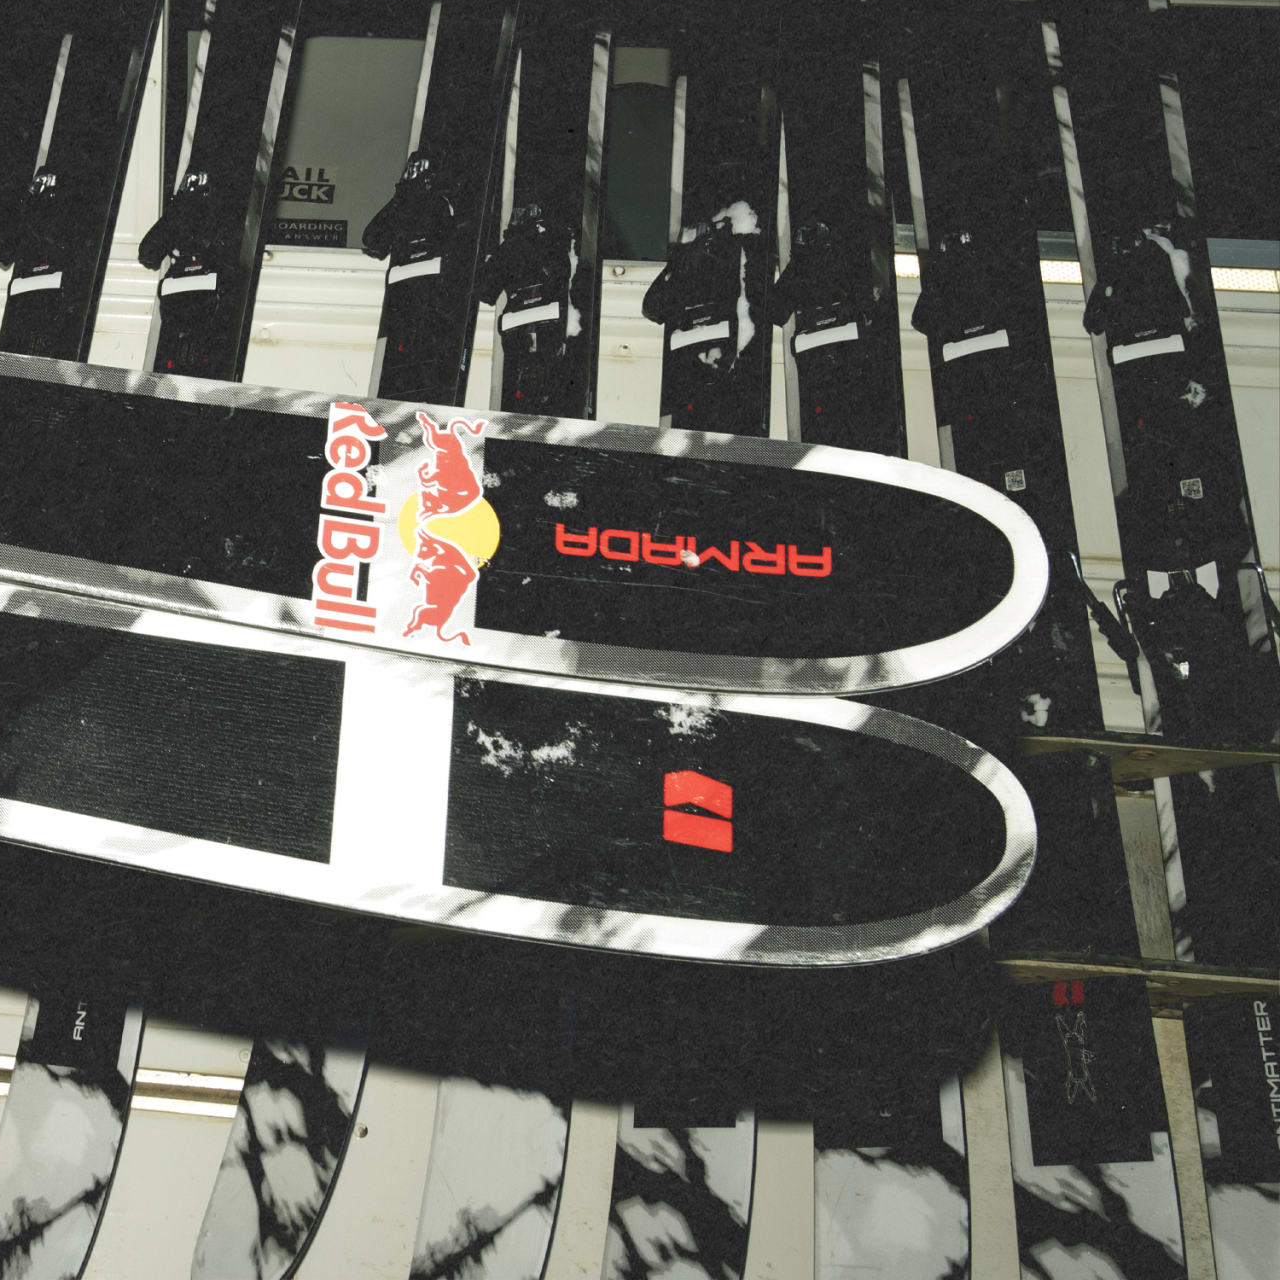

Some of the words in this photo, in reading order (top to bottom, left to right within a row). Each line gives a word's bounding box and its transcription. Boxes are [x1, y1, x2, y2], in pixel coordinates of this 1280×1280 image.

[280, 166, 330, 182] AIL
[274, 222, 344, 232] OARDING
[326, 402, 388, 514] Red
[314, 519, 381, 634] Bull
[555, 523, 833, 578] ARMADA
